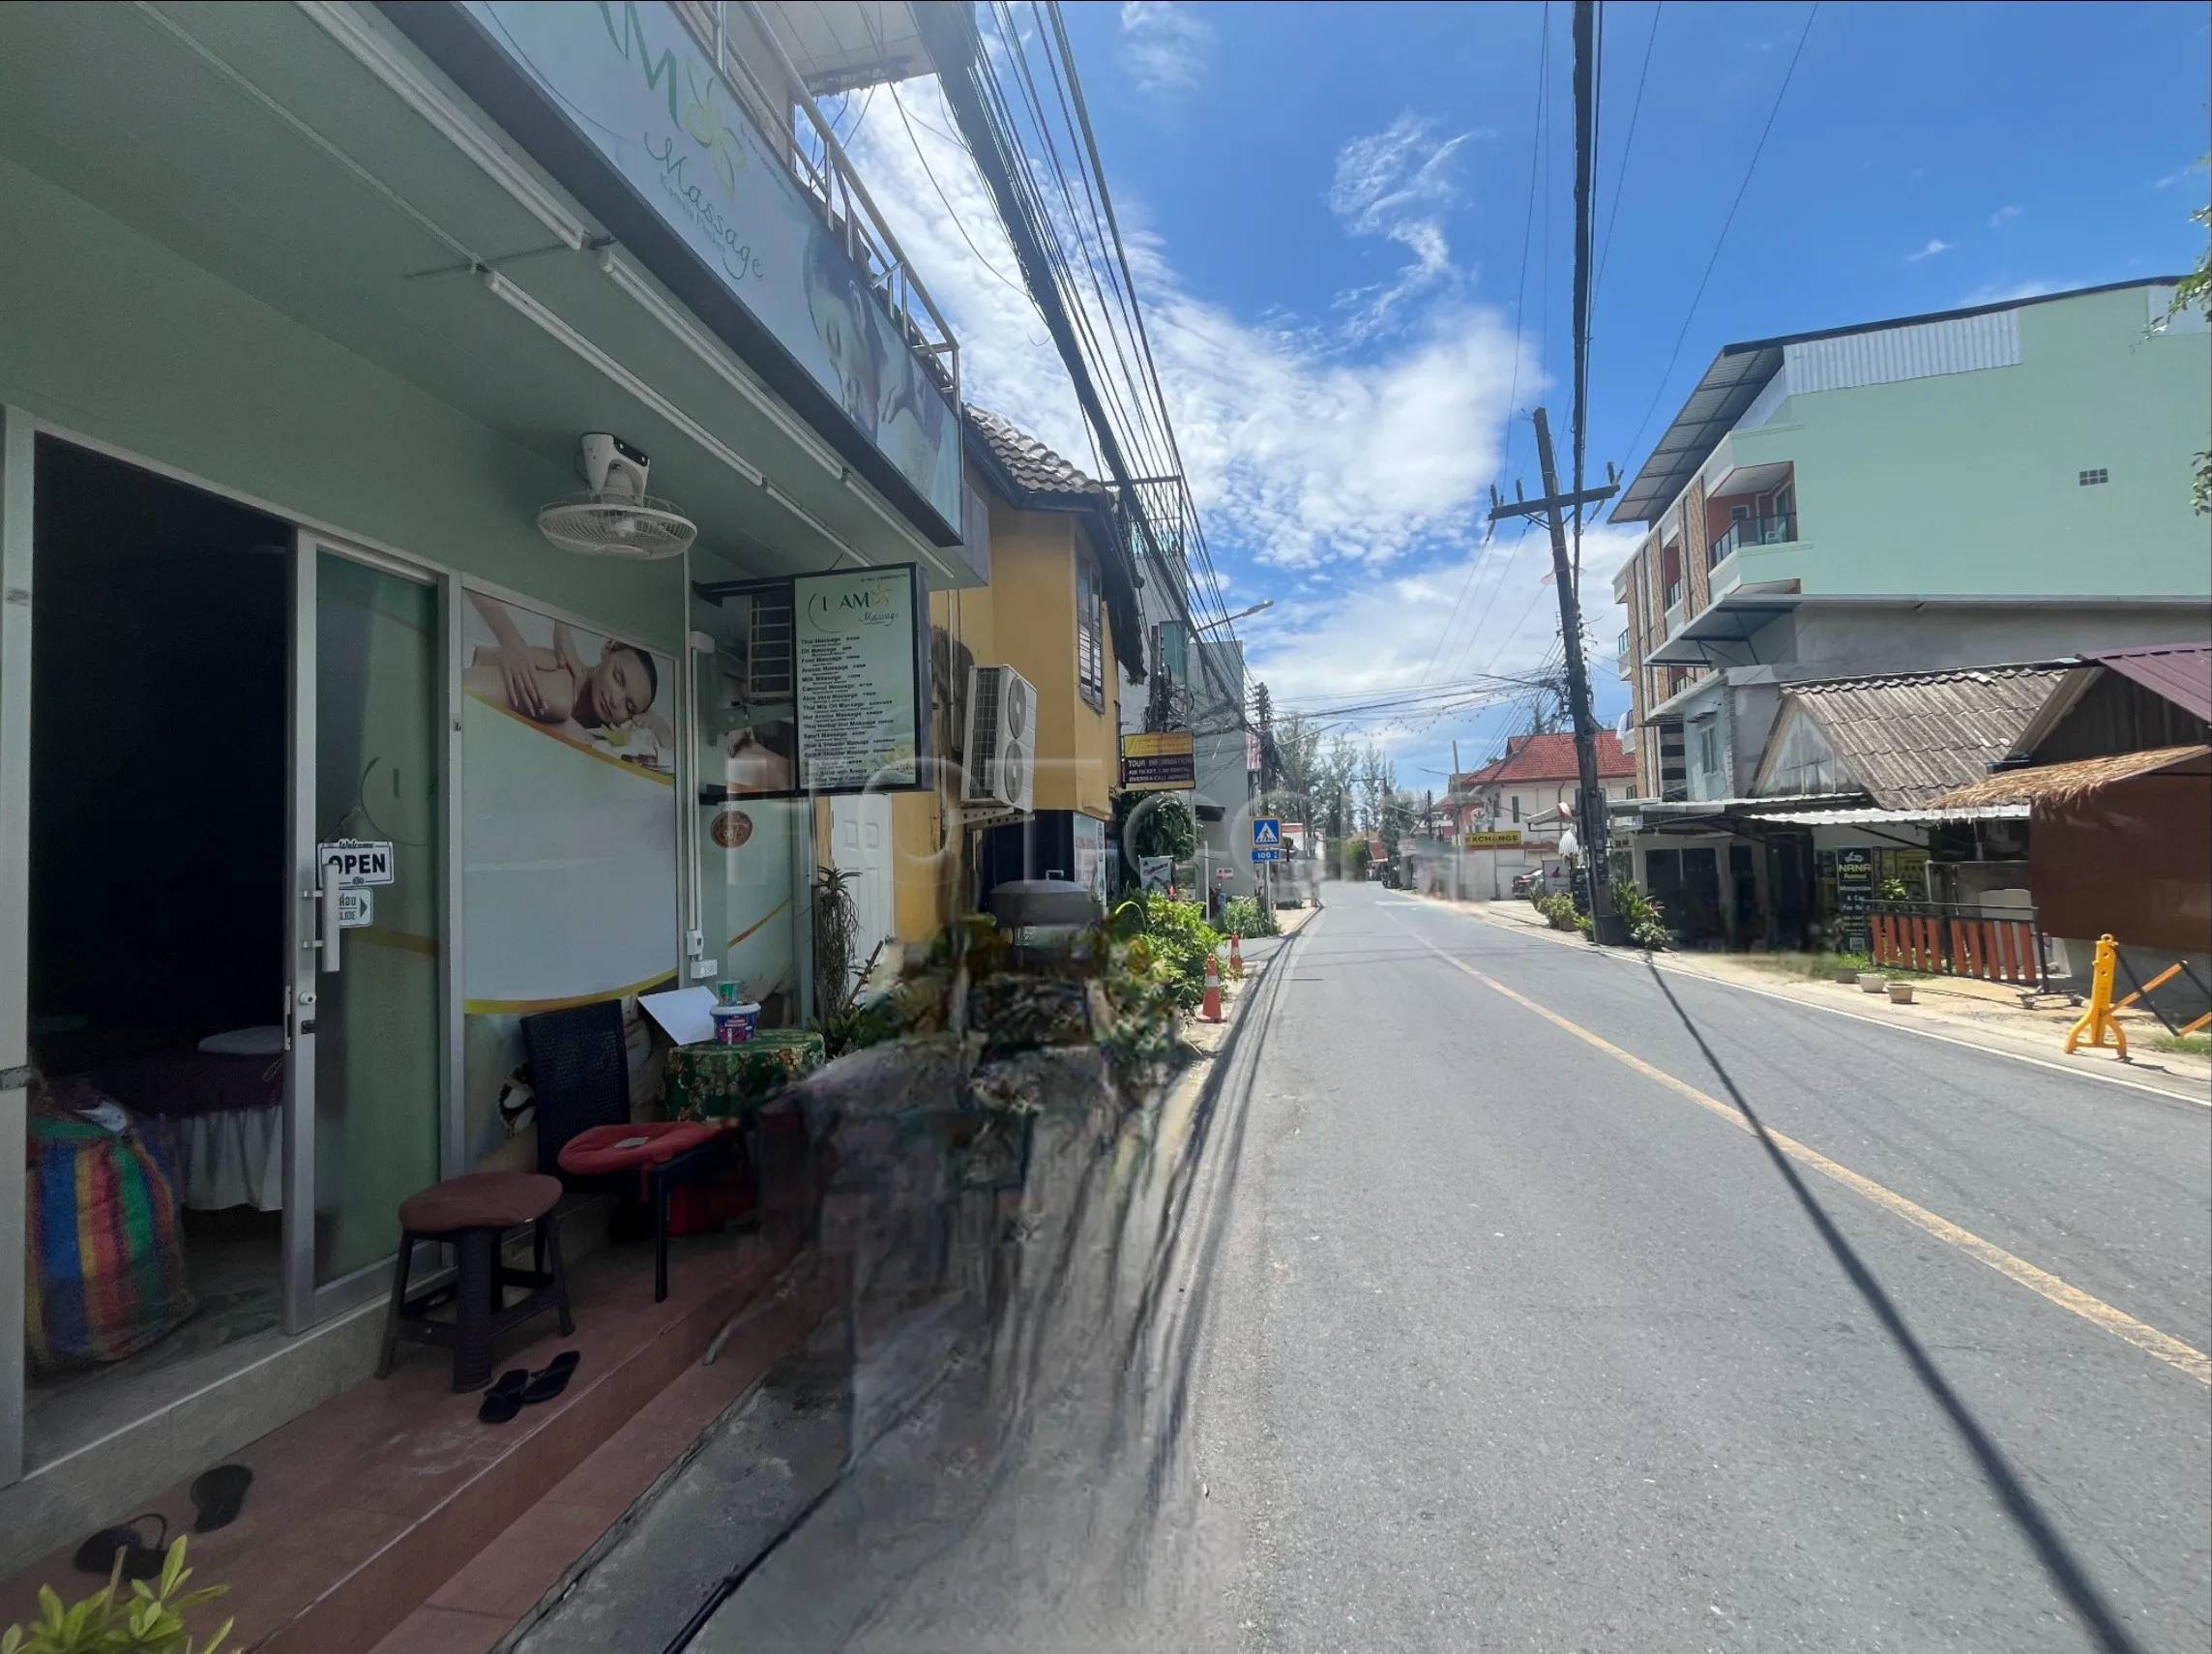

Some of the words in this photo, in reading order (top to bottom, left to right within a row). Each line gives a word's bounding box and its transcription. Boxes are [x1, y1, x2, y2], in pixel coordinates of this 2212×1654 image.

[643, 132, 765, 281] Massage
[839, 591, 871, 609] AM
[1128, 759, 1146, 768] TOUR
[1148, 757, 1193, 766] INFORMATION
